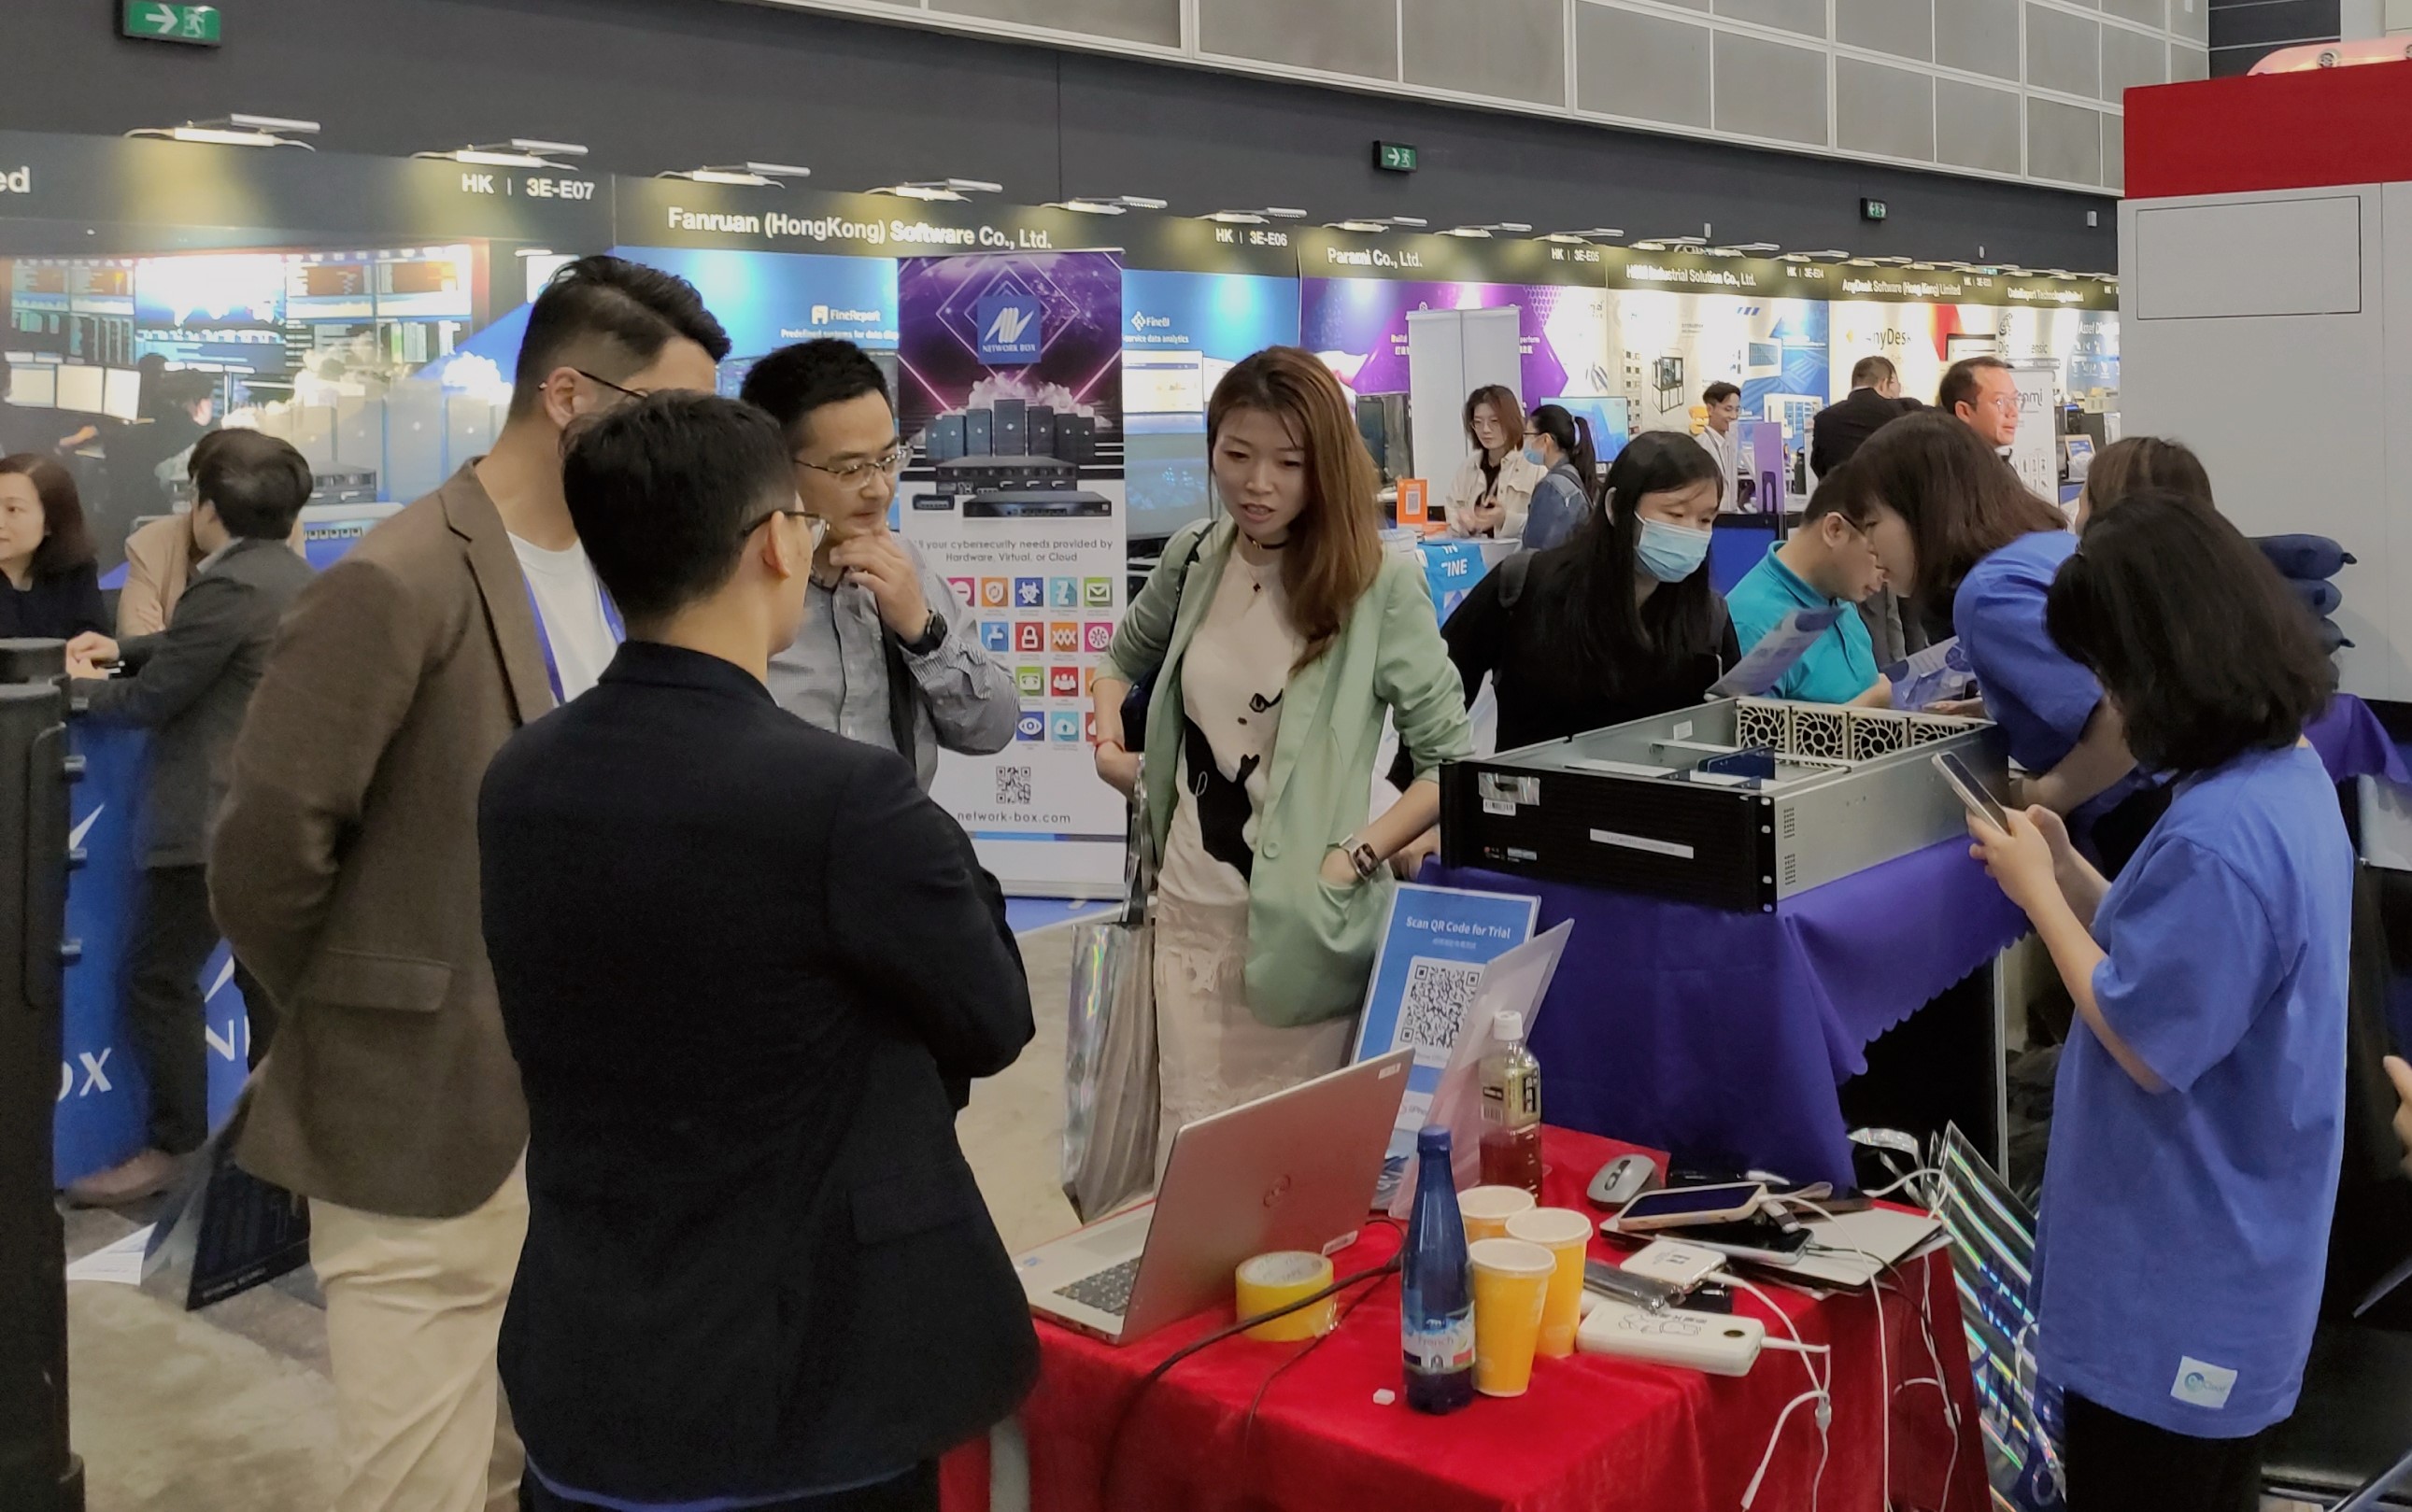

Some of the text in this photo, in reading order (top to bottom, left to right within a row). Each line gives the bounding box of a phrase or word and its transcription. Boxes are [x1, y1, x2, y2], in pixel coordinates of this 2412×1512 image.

[461, 173, 494, 194] HK
[526, 177, 595, 200] 3E-E07
[668, 206, 1052, 249] Fanruan (HongKong) Software Co., Ltd.
[1215, 228, 1233, 243] HK
[1250, 231, 1287, 247] 3E-E06
[1327, 247, 1423, 269] Parami Co., Ltd.
[1552, 247, 1564, 261] HK
[1574, 249, 1599, 262] 3E-E05
[1786, 266, 1797, 277] HK
[1740, 272, 1757, 287] Ltd.
[1873, 280, 1902, 294] Software
[983, 344, 1036, 353] NETWORK BOX
[927, 541, 947, 551] your
[951, 540, 1016, 551] cybersecurity
[1019, 540, 1049, 549] needs
[1053, 540, 1097, 549] provided
[1100, 539, 1113, 550] by
[1048, 552, 1077, 561] Cloud
[957, 812, 1071, 824] network-box.com
[1406, 916, 1511, 940] Scan QR Code for Trial
